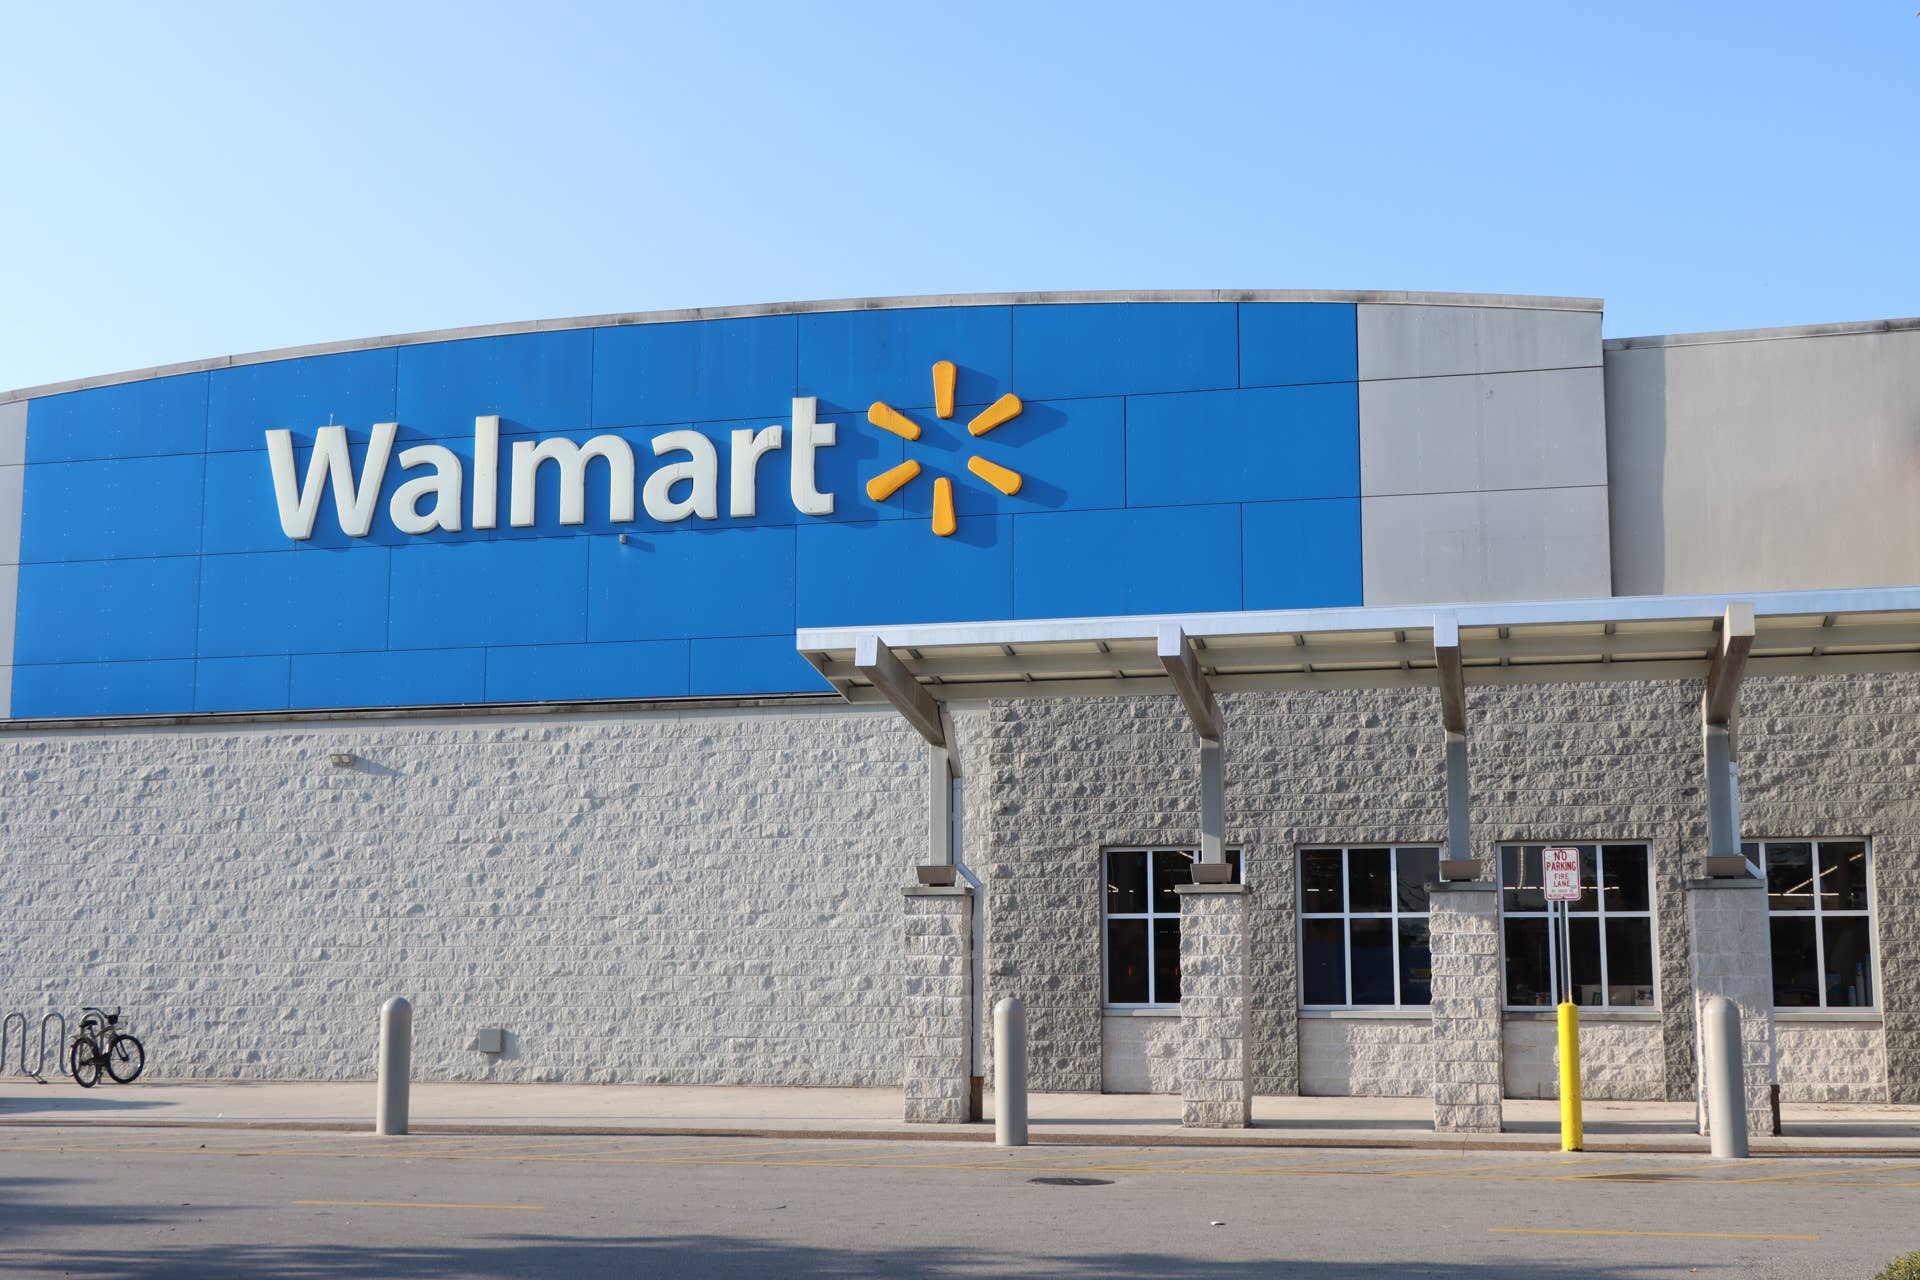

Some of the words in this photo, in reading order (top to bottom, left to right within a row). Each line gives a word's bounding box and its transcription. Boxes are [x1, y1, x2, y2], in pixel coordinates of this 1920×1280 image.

[264, 396, 837, 540] Walmart
[1554, 851, 1567, 861] NO
[1546, 862, 1576, 871] PARKING
